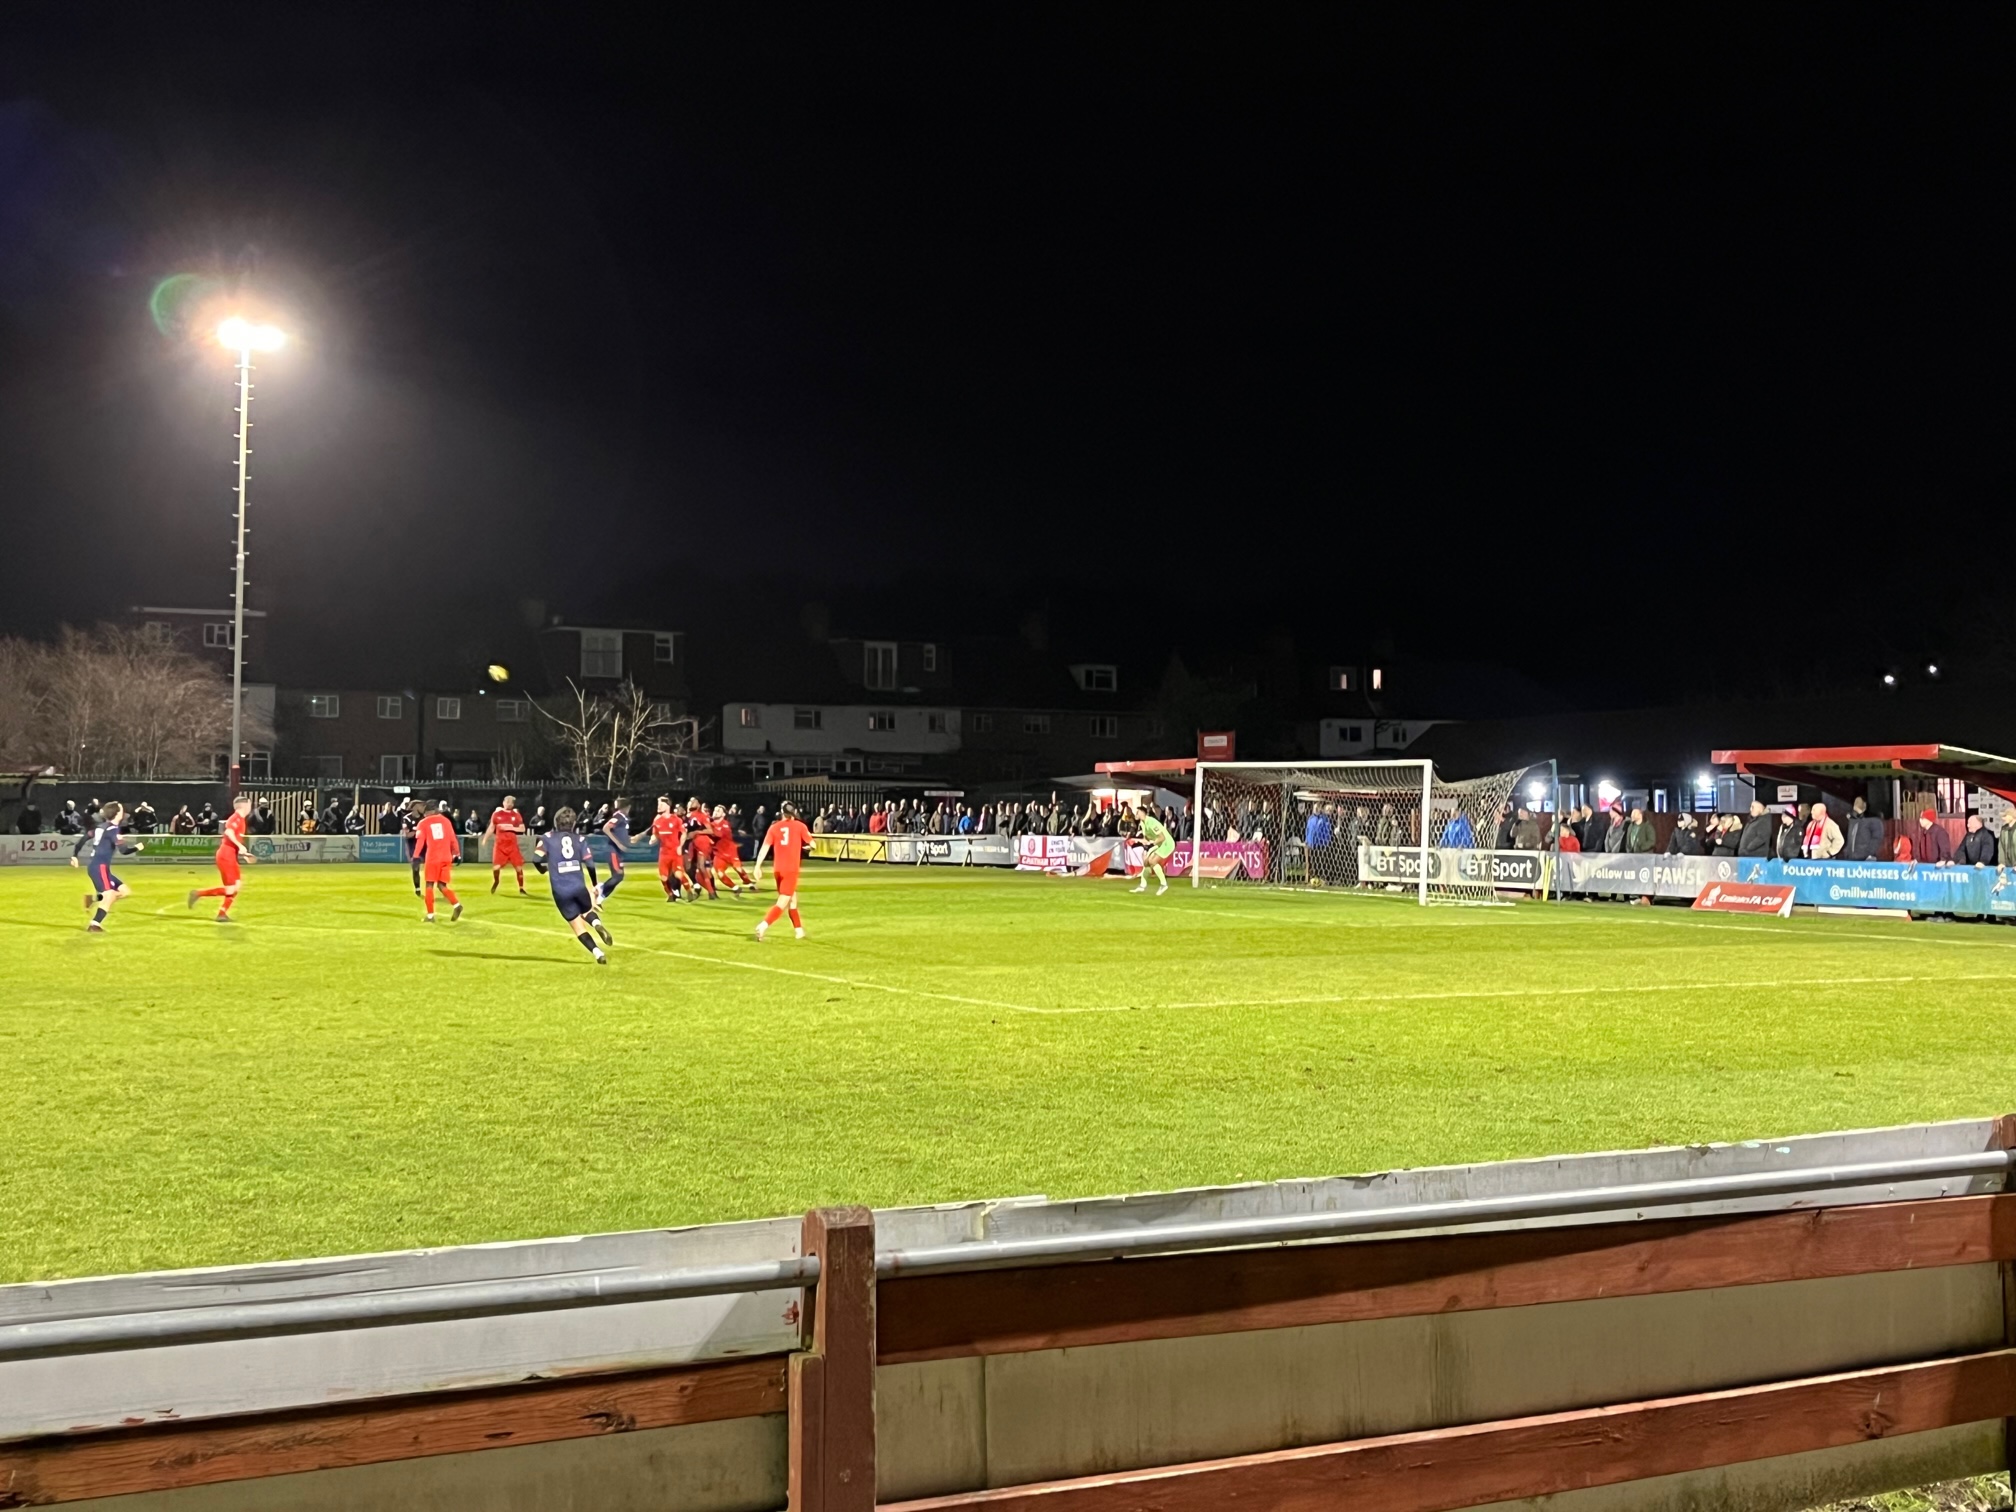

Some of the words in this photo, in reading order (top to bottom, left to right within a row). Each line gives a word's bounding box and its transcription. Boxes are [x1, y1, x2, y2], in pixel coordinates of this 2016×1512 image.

[171, 838, 209, 846] HARRIS
[780, 827, 789, 845] 3
[21, 840, 35, 851] 12
[39, 840, 58, 851] 30
[561, 836, 574, 859] 8
[930, 842, 949, 856] Sport
[1376, 857, 1397, 872] BT
[1399, 857, 1434, 876] Spot
[1466, 858, 1489, 875] BT
[1491, 858, 1533, 881] Sport
[1591, 867, 1623, 880] Follow
[1624, 870, 1636, 880] us
[1783, 865, 1823, 876] FOLLOW
[1826, 867, 1844, 878] THE
[1847, 868, 1899, 880] LIONESSES
[1901, 870, 1918, 880] ON
[1921, 870, 1969, 883] TWITTER
[1748, 895, 1760, 905] FA
[1762, 895, 1782, 906] CUP
[1829, 884, 1916, 901] @millwalllioness
